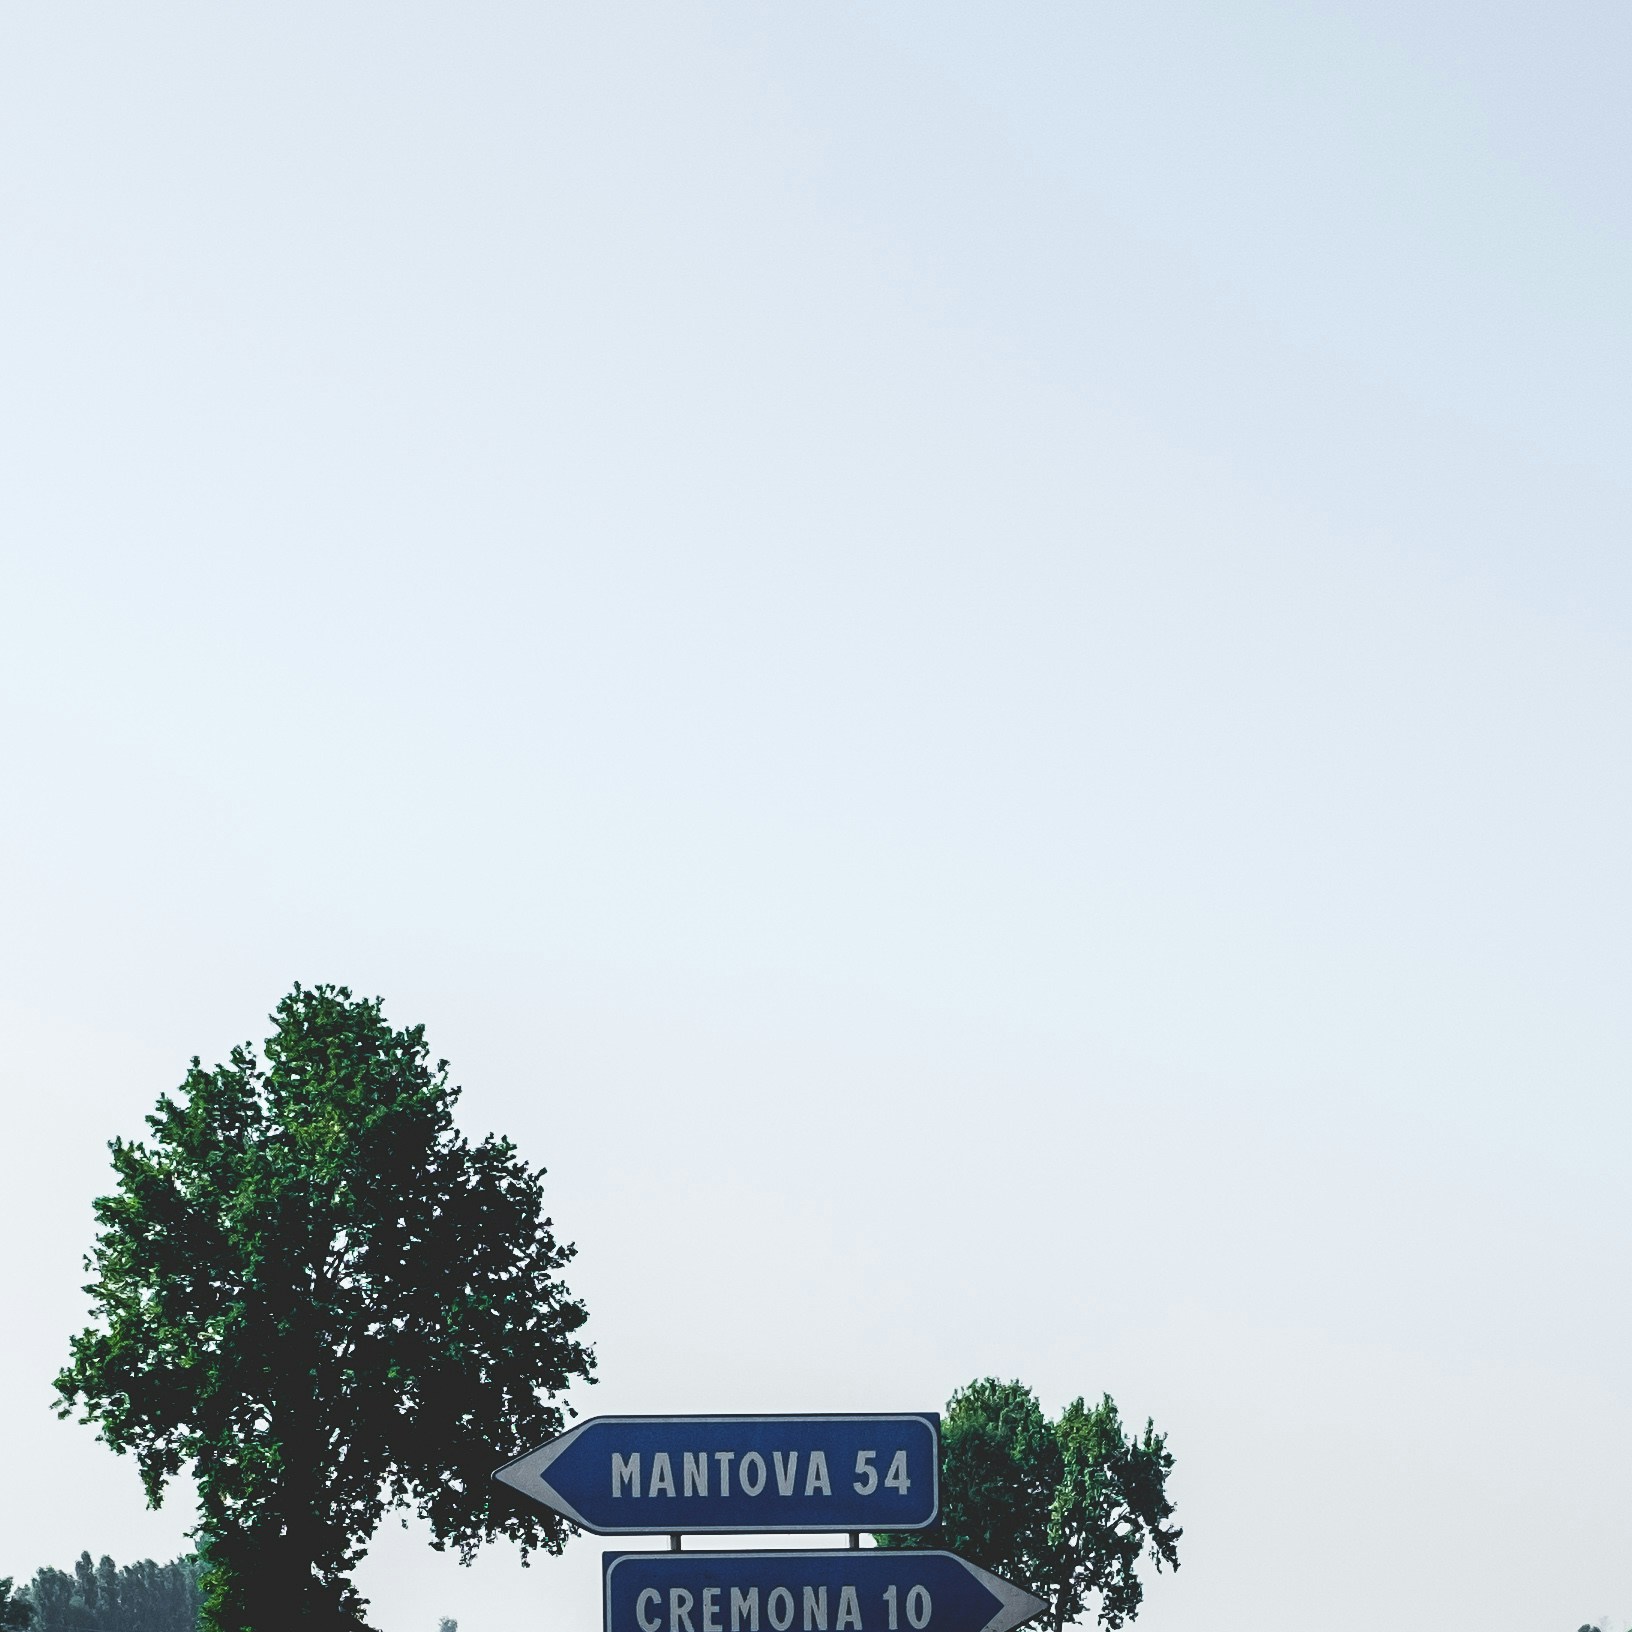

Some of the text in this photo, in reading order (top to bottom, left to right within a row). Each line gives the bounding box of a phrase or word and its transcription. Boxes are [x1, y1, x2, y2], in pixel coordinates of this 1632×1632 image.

[611, 1450, 911, 1498] MANTOVA 54
[883, 1584, 932, 1630] 10
